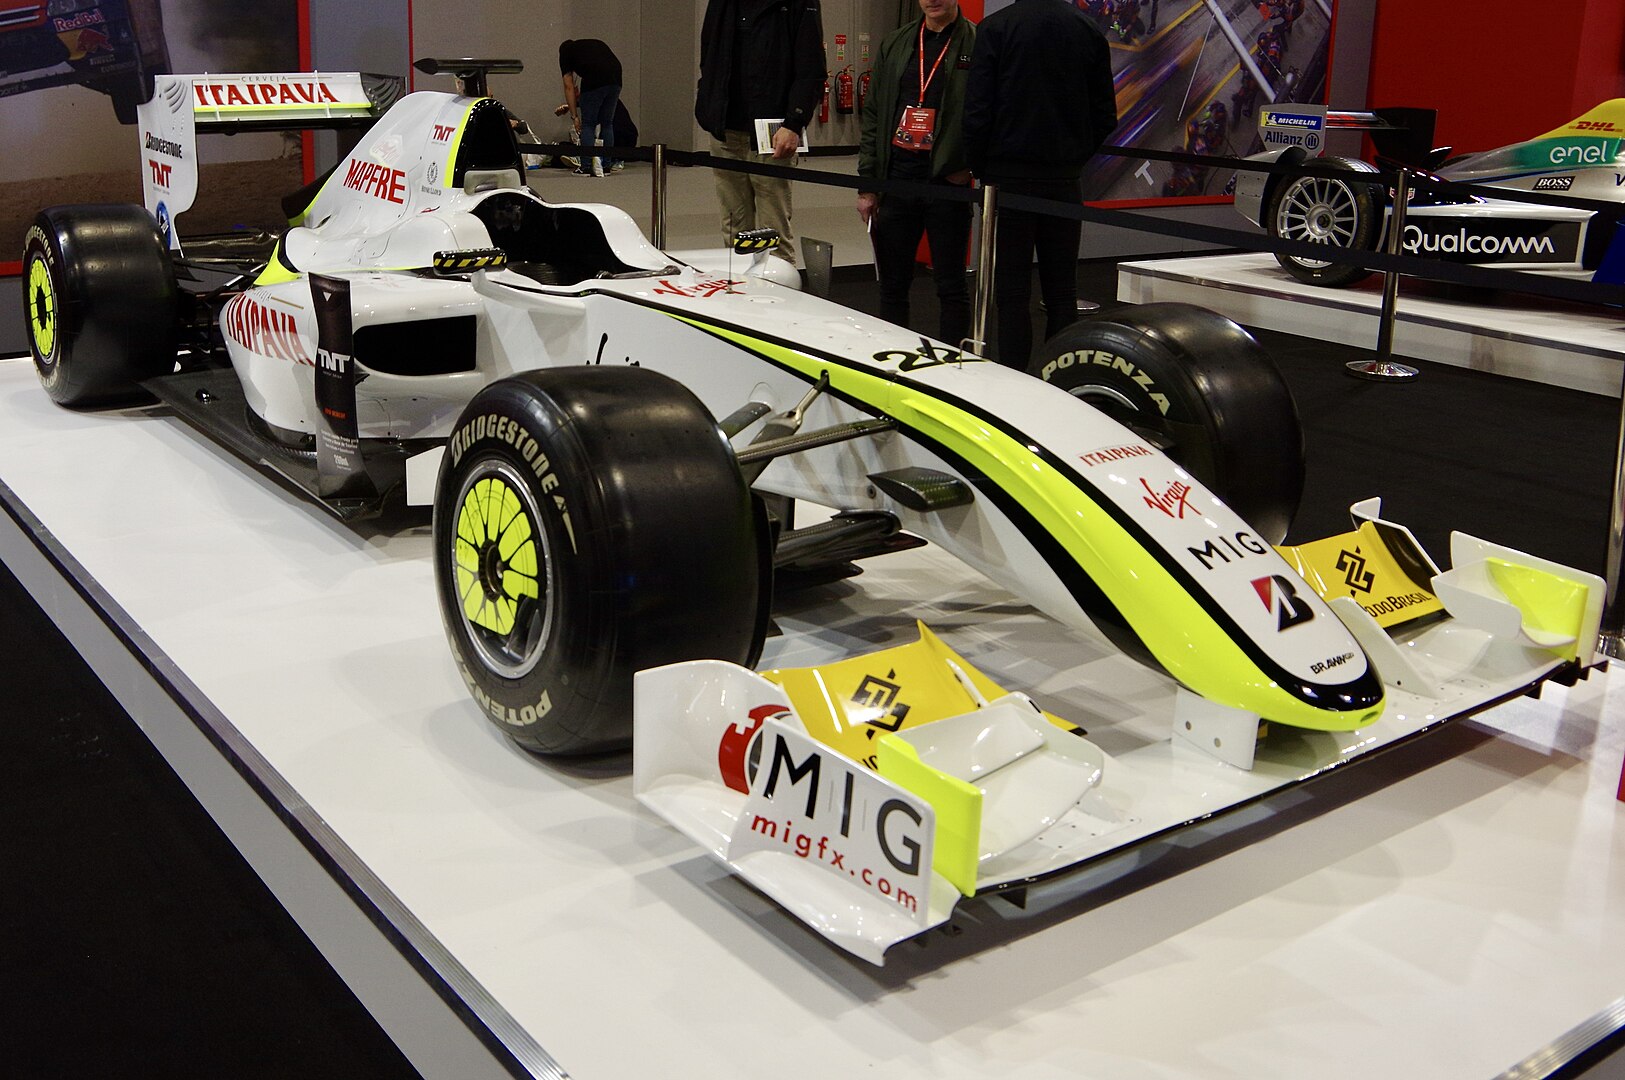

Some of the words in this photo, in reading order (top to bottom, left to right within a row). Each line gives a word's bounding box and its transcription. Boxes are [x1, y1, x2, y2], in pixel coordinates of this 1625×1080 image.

[54, 13, 83, 31] Red
[194, 82, 341, 106] ITAIPAVA
[433, 124, 456, 142] TNT
[1277, 117, 1317, 126] MICHELIN
[1575, 121, 1615, 131] DHL
[145, 131, 182, 159] BRIDGESTONE
[1264, 131, 1303, 145] Allianz
[1549, 141, 1607, 163] enel
[149, 159, 172, 188] TNT
[343, 158, 406, 205] MAPFRE
[1538, 177, 1571, 187] BOSS
[1615, 173, 1625, 187] V
[1403, 225, 1555, 254] Qualcomm
[318, 348, 351, 373] TNT
[1041, 349, 1171, 416] POTENZA
[451, 414, 560, 494] BRIDGESTONE
[1079, 444, 1155, 467] ITAIPAVA
[1139, 477, 1202, 520] Virgin
[1187, 531, 1267, 570] MIG
[1386, 592, 1432, 610] BRASIL
[763, 733, 923, 876] MIG
[751, 814, 917, 913] migfx.com
